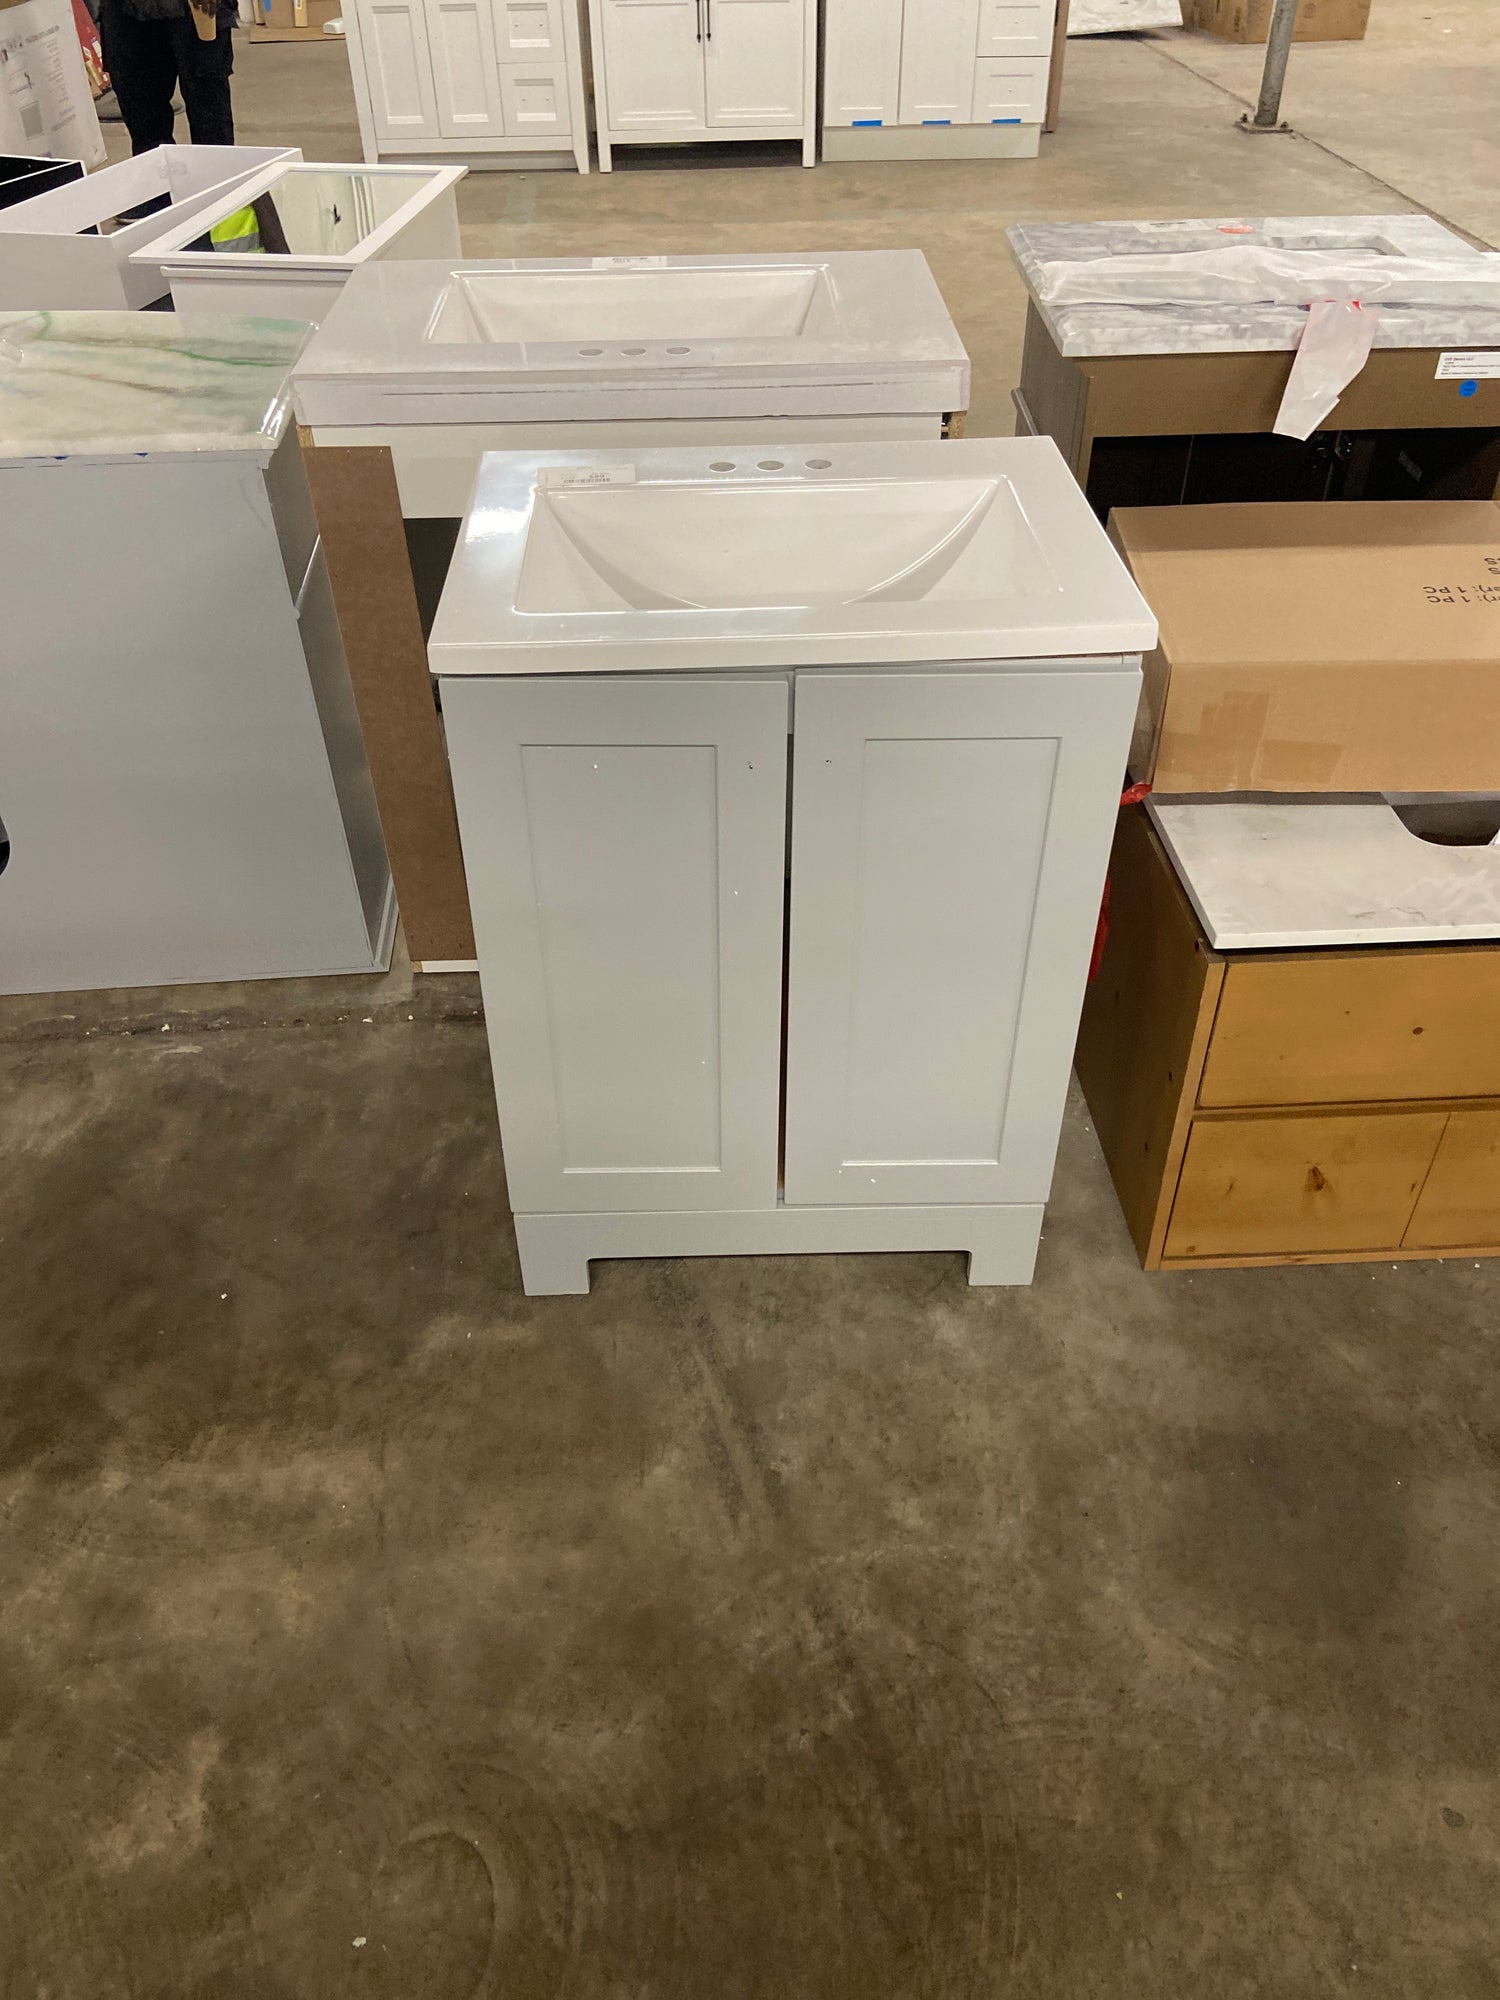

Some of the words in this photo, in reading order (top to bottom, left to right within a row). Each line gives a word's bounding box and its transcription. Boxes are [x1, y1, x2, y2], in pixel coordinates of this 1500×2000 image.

[1423, 586, 1451, 594] PC
[1426, 595, 1455, 603] PC
[1461, 595, 1471, 603] 1
